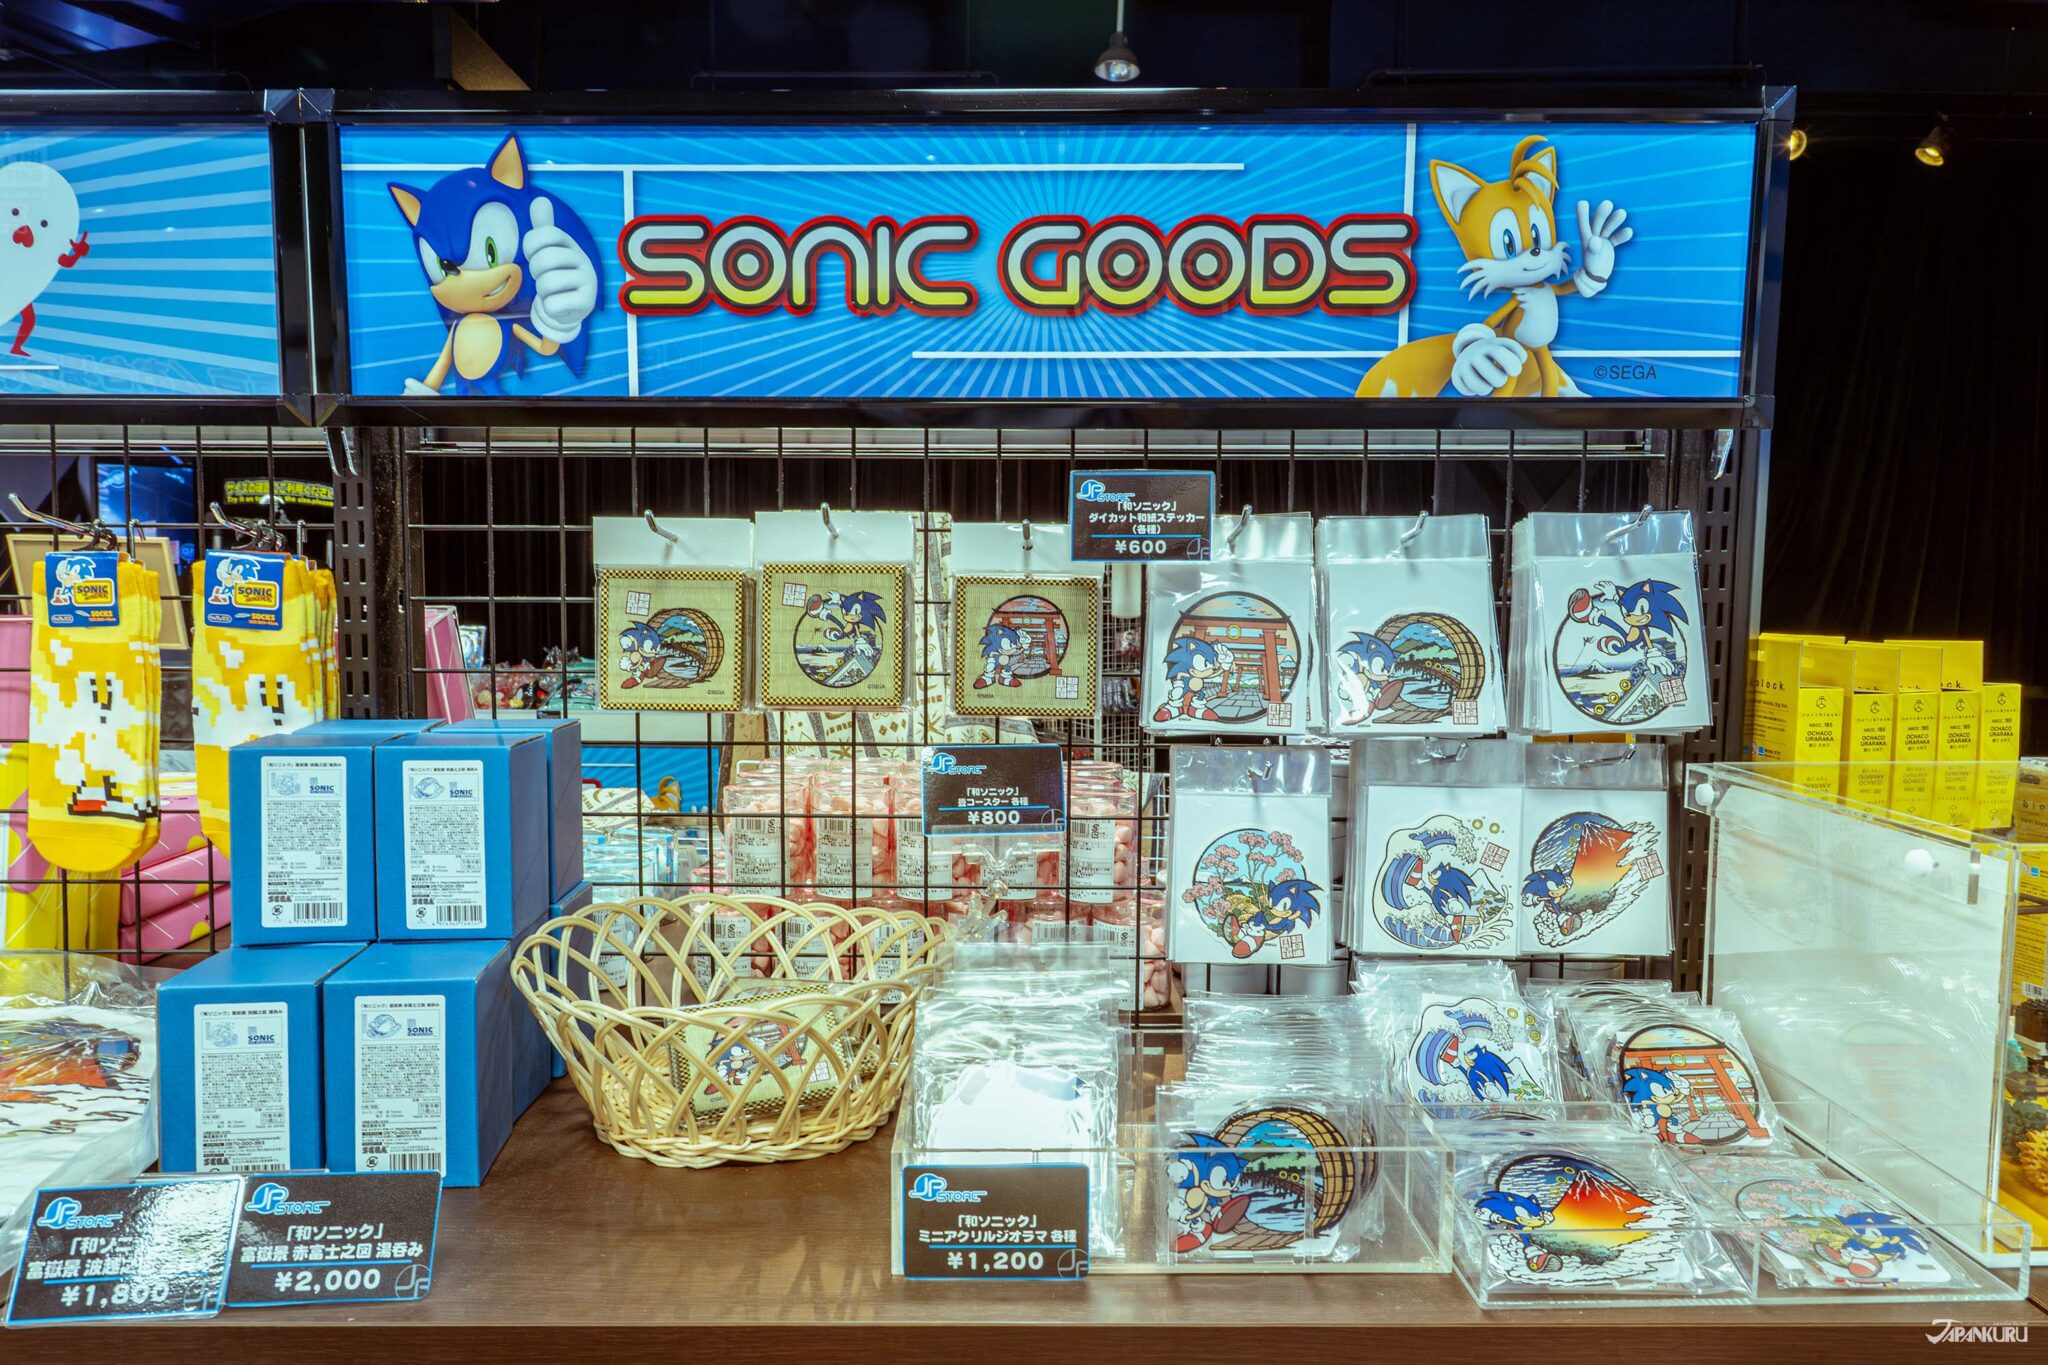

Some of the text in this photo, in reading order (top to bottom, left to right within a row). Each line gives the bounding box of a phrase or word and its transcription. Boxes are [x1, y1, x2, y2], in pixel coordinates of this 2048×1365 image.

[617, 213, 1418, 316] SONIC GOODS
[1593, 365, 1657, 380] ©SEGA
[1117, 501, 1177, 511] 「和ソニック」
[1089, 513, 1205, 523] ダイカット和紙ステッカー
[1115, 540, 1167, 554] ¥600
[77, 585, 108, 594] SONIC
[238, 586, 272, 597] SONIC
[966, 787, 1019, 796] 「和ソニック」
[968, 811, 1020, 825] ¥800
[268, 895, 292, 903] SEGA
[362, 1146, 388, 1154] SEGA
[203, 1157, 229, 1166] SEGA
[958, 1214, 1037, 1228] 「和ソニック」
[286, 1223, 384, 1241] 「和ソニック」
[919, 1230, 1077, 1243] ミニアクリルジオラマ 各種
[240, 1245, 289, 1262] 富嶽景
[292, 1243, 372, 1260] 赤富士之図
[376, 1241, 423, 1258] 湯呑み
[947, 1252, 1044, 1272] ¥1,200
[26, 1259, 81, 1280] 富嶽景
[274, 1268, 381, 1294] ¥2,000
[61, 1280, 170, 1308] ¥1,800
